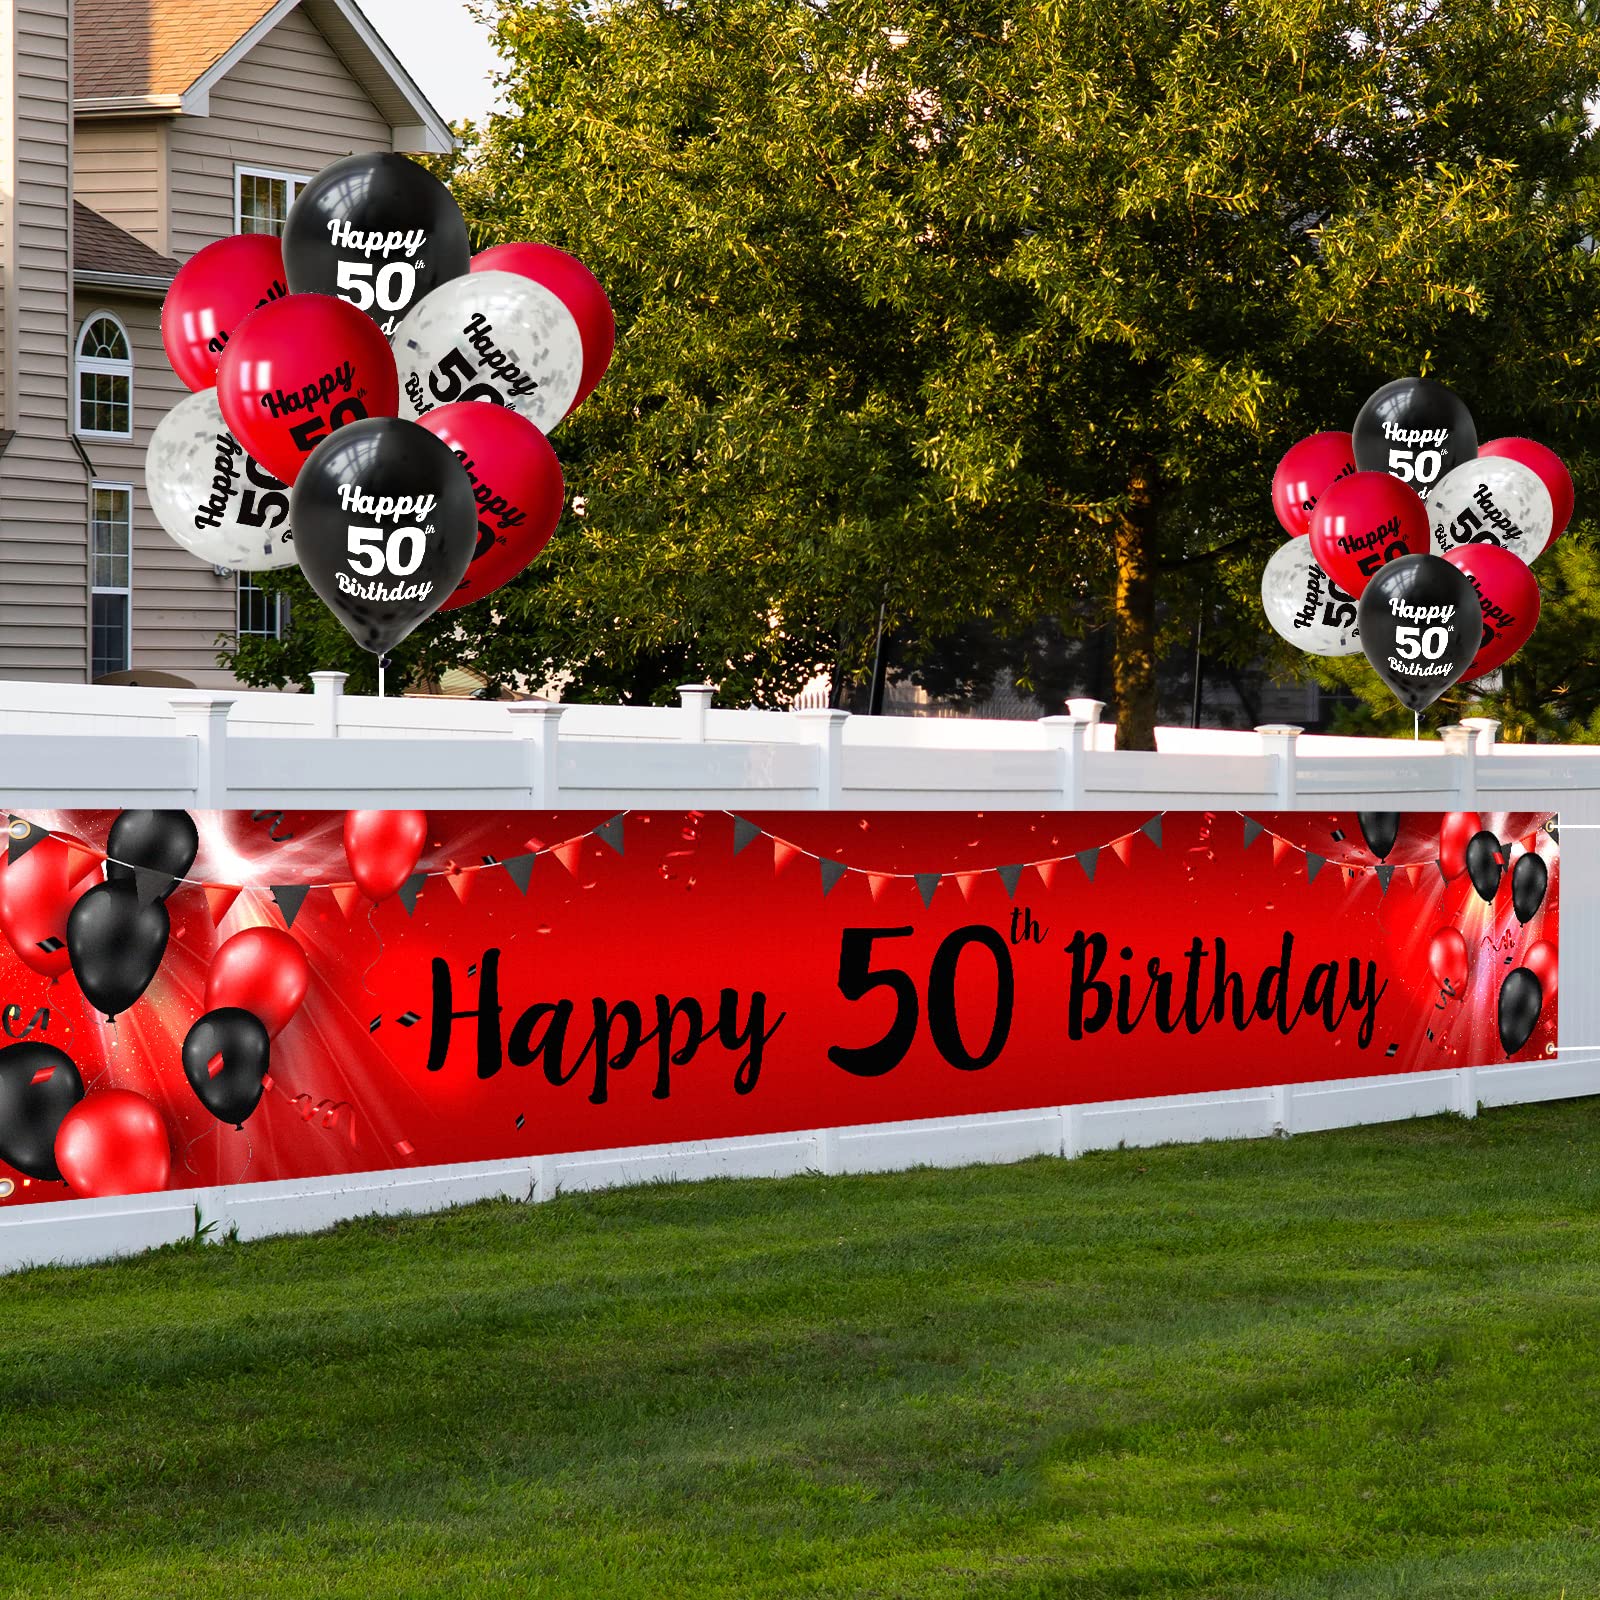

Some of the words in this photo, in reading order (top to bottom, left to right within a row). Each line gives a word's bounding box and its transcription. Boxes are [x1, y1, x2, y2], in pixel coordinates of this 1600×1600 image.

[327, 218, 427, 259] Happy
[463, 312, 539, 397] Happy
[261, 360, 356, 419] Happy
[1381, 421, 1449, 448] Happy
[194, 432, 243, 530] Happy
[235, 454, 290, 530] 50
[337, 483, 438, 524] Happy
[1337, 515, 1402, 555] Happy
[1473, 483, 1524, 541] Happy
[346, 524, 436, 577] 50th
[334, 571, 434, 602] Birthday
[1293, 563, 1327, 629] Happy
[1388, 597, 1456, 625] Happy
[1387, 656, 1454, 677] Birthday
[427, 948, 787, 1104] Happy
[827, 906, 1049, 1077] 50th
[1065, 929, 1389, 1050] Birthday
